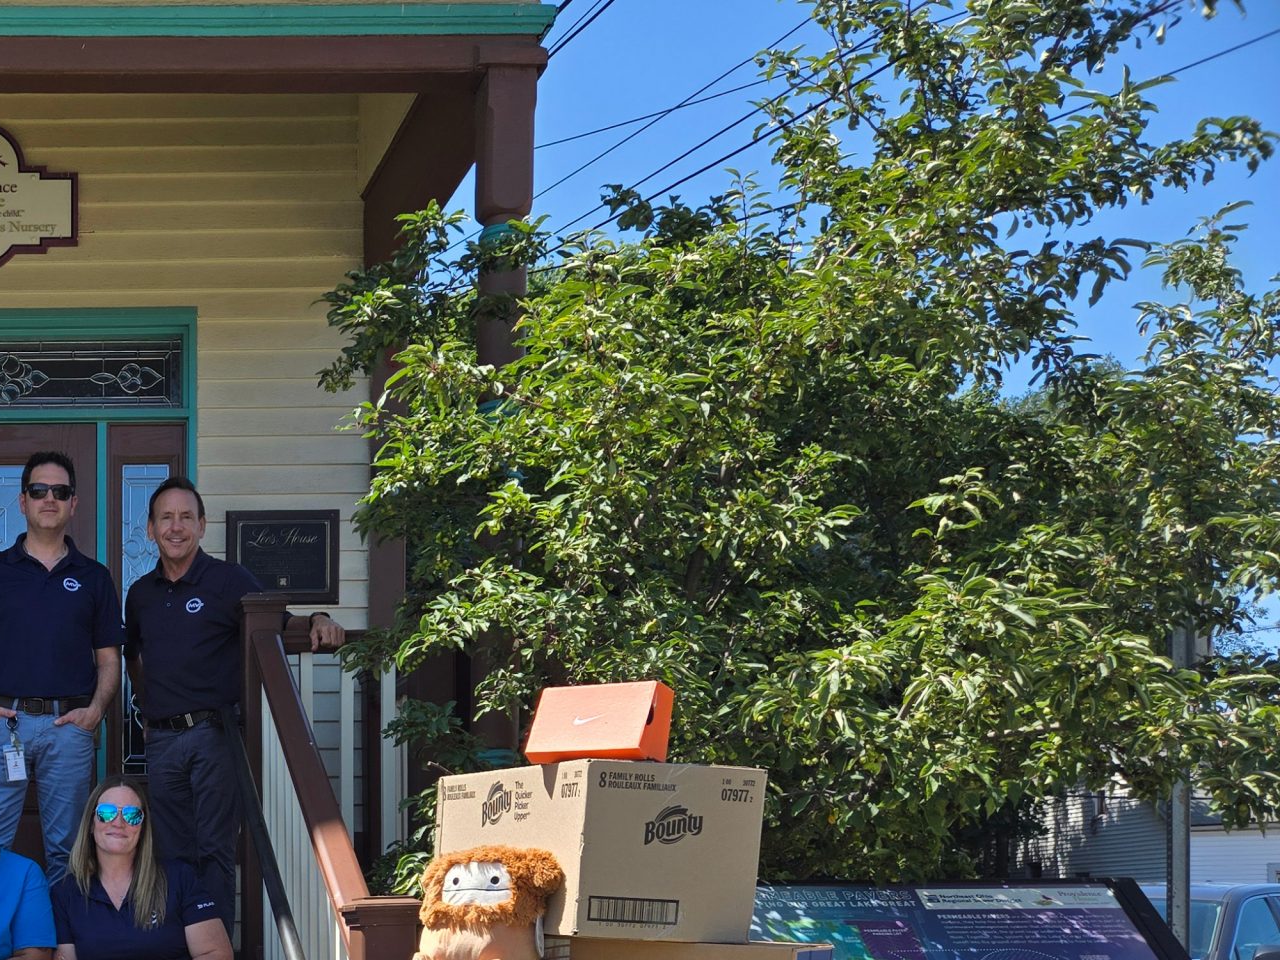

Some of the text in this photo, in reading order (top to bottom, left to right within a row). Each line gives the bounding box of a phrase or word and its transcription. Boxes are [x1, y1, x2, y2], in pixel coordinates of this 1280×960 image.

[9, 221, 57, 236] Nursery
[280, 527, 318, 548] House
[598, 771, 607, 788] 8
[609, 772, 655, 782] FAMILY ROLLS
[561, 782, 578, 799] 07977
[608, 780, 676, 792] ROULEAUX FAMILIAUX
[721, 788, 749, 803] 07977
[482, 788, 512, 828] Bounty
[644, 812, 704, 846] Bounty
[842, 890, 912, 900] PAVERS
